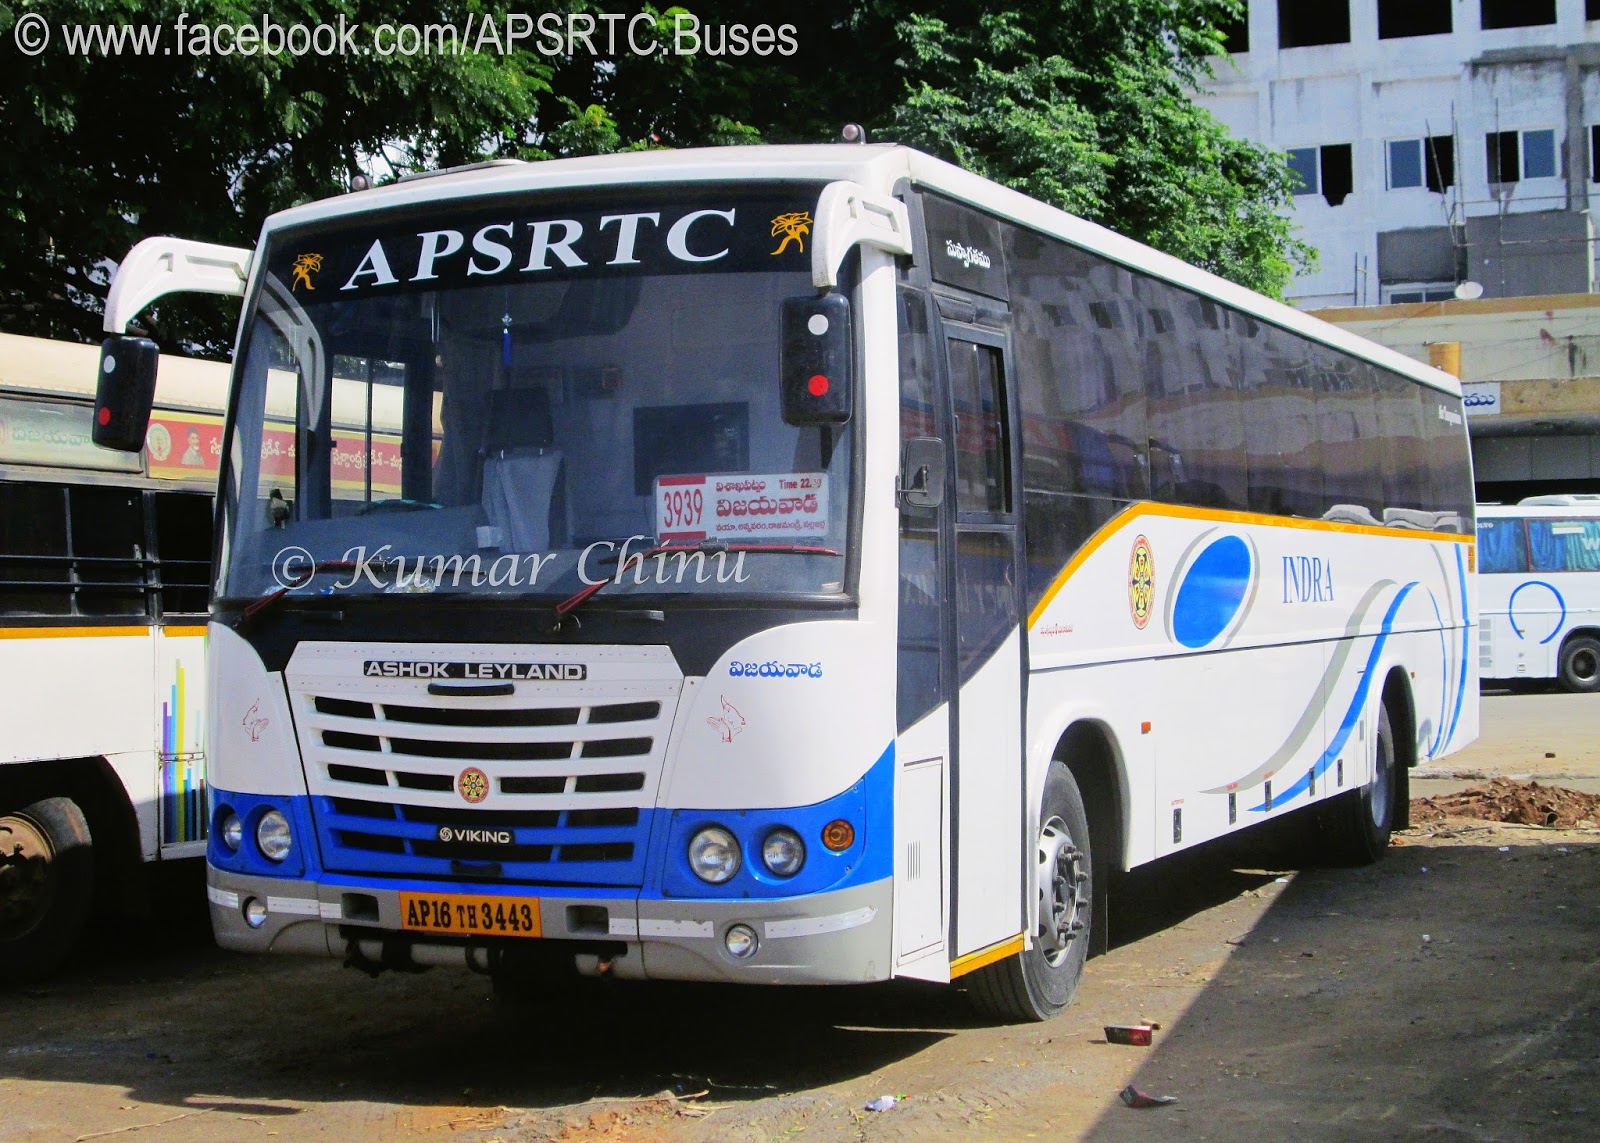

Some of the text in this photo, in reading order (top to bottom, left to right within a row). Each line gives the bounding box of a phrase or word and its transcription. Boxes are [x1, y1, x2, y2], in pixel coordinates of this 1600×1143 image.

[339, 207, 736, 291] APSRTC
[779, 479, 798, 489] Time
[664, 488, 703, 528] 3939
[716, 494, 818, 517] విజయవాడ
[1282, 556, 1334, 604] INDRA
[366, 662, 584, 681] ASHOK LEYLAND
[729, 660, 823, 679] విజయవాడ
[454, 829, 511, 844] VIKING
[407, 899, 533, 932] AP16 TH 3443
